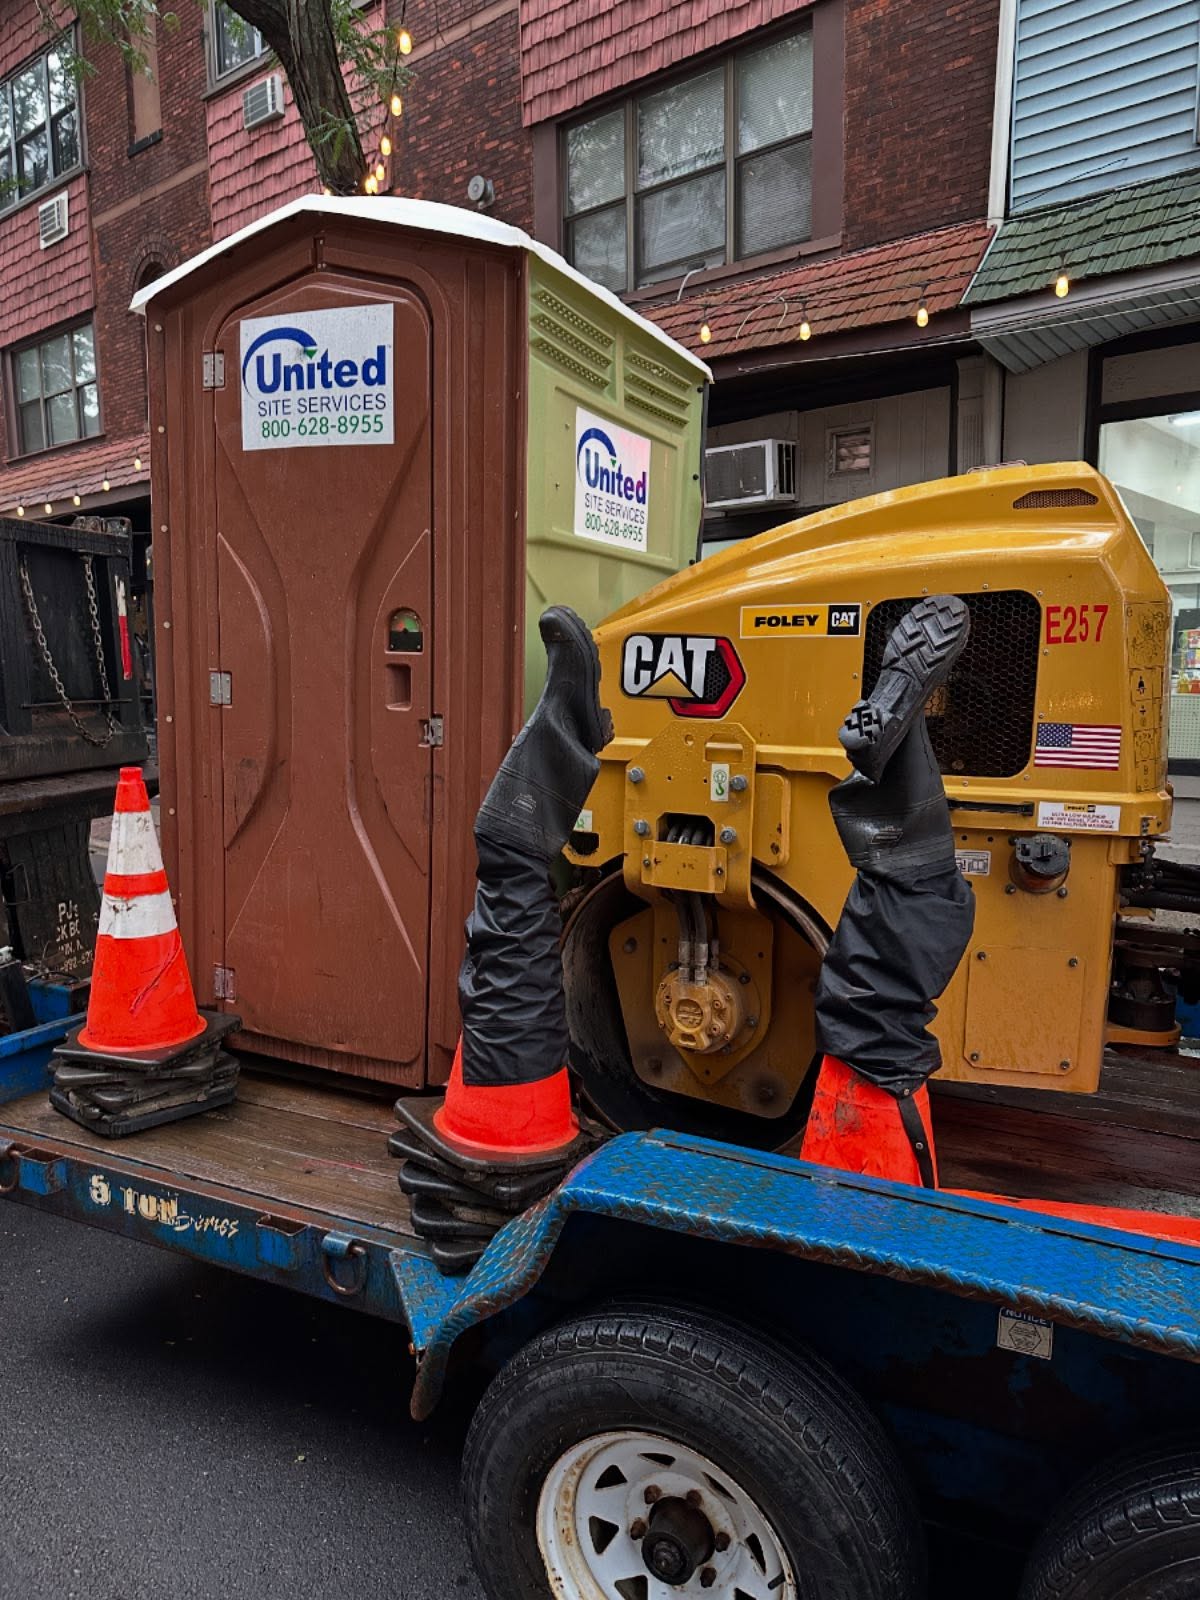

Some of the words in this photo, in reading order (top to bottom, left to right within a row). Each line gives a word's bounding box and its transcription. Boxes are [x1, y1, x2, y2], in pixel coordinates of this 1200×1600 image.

[256, 345, 387, 394] United
[258, 399, 292, 418] SITE
[297, 393, 387, 415] SERVICES
[261, 414, 384, 439] 800-628-8955
[585, 447, 647, 505] United
[584, 492, 603, 513] SITE
[604, 501, 645, 525] SERVICES
[584, 511, 643, 542] 800-628-8955
[754, 614, 819, 628] FOLEY
[831, 611, 857, 628] CAT
[1046, 604, 1109, 645] E257
[623, 634, 716, 699] CAT
[89, 1174, 111, 1206] 5
